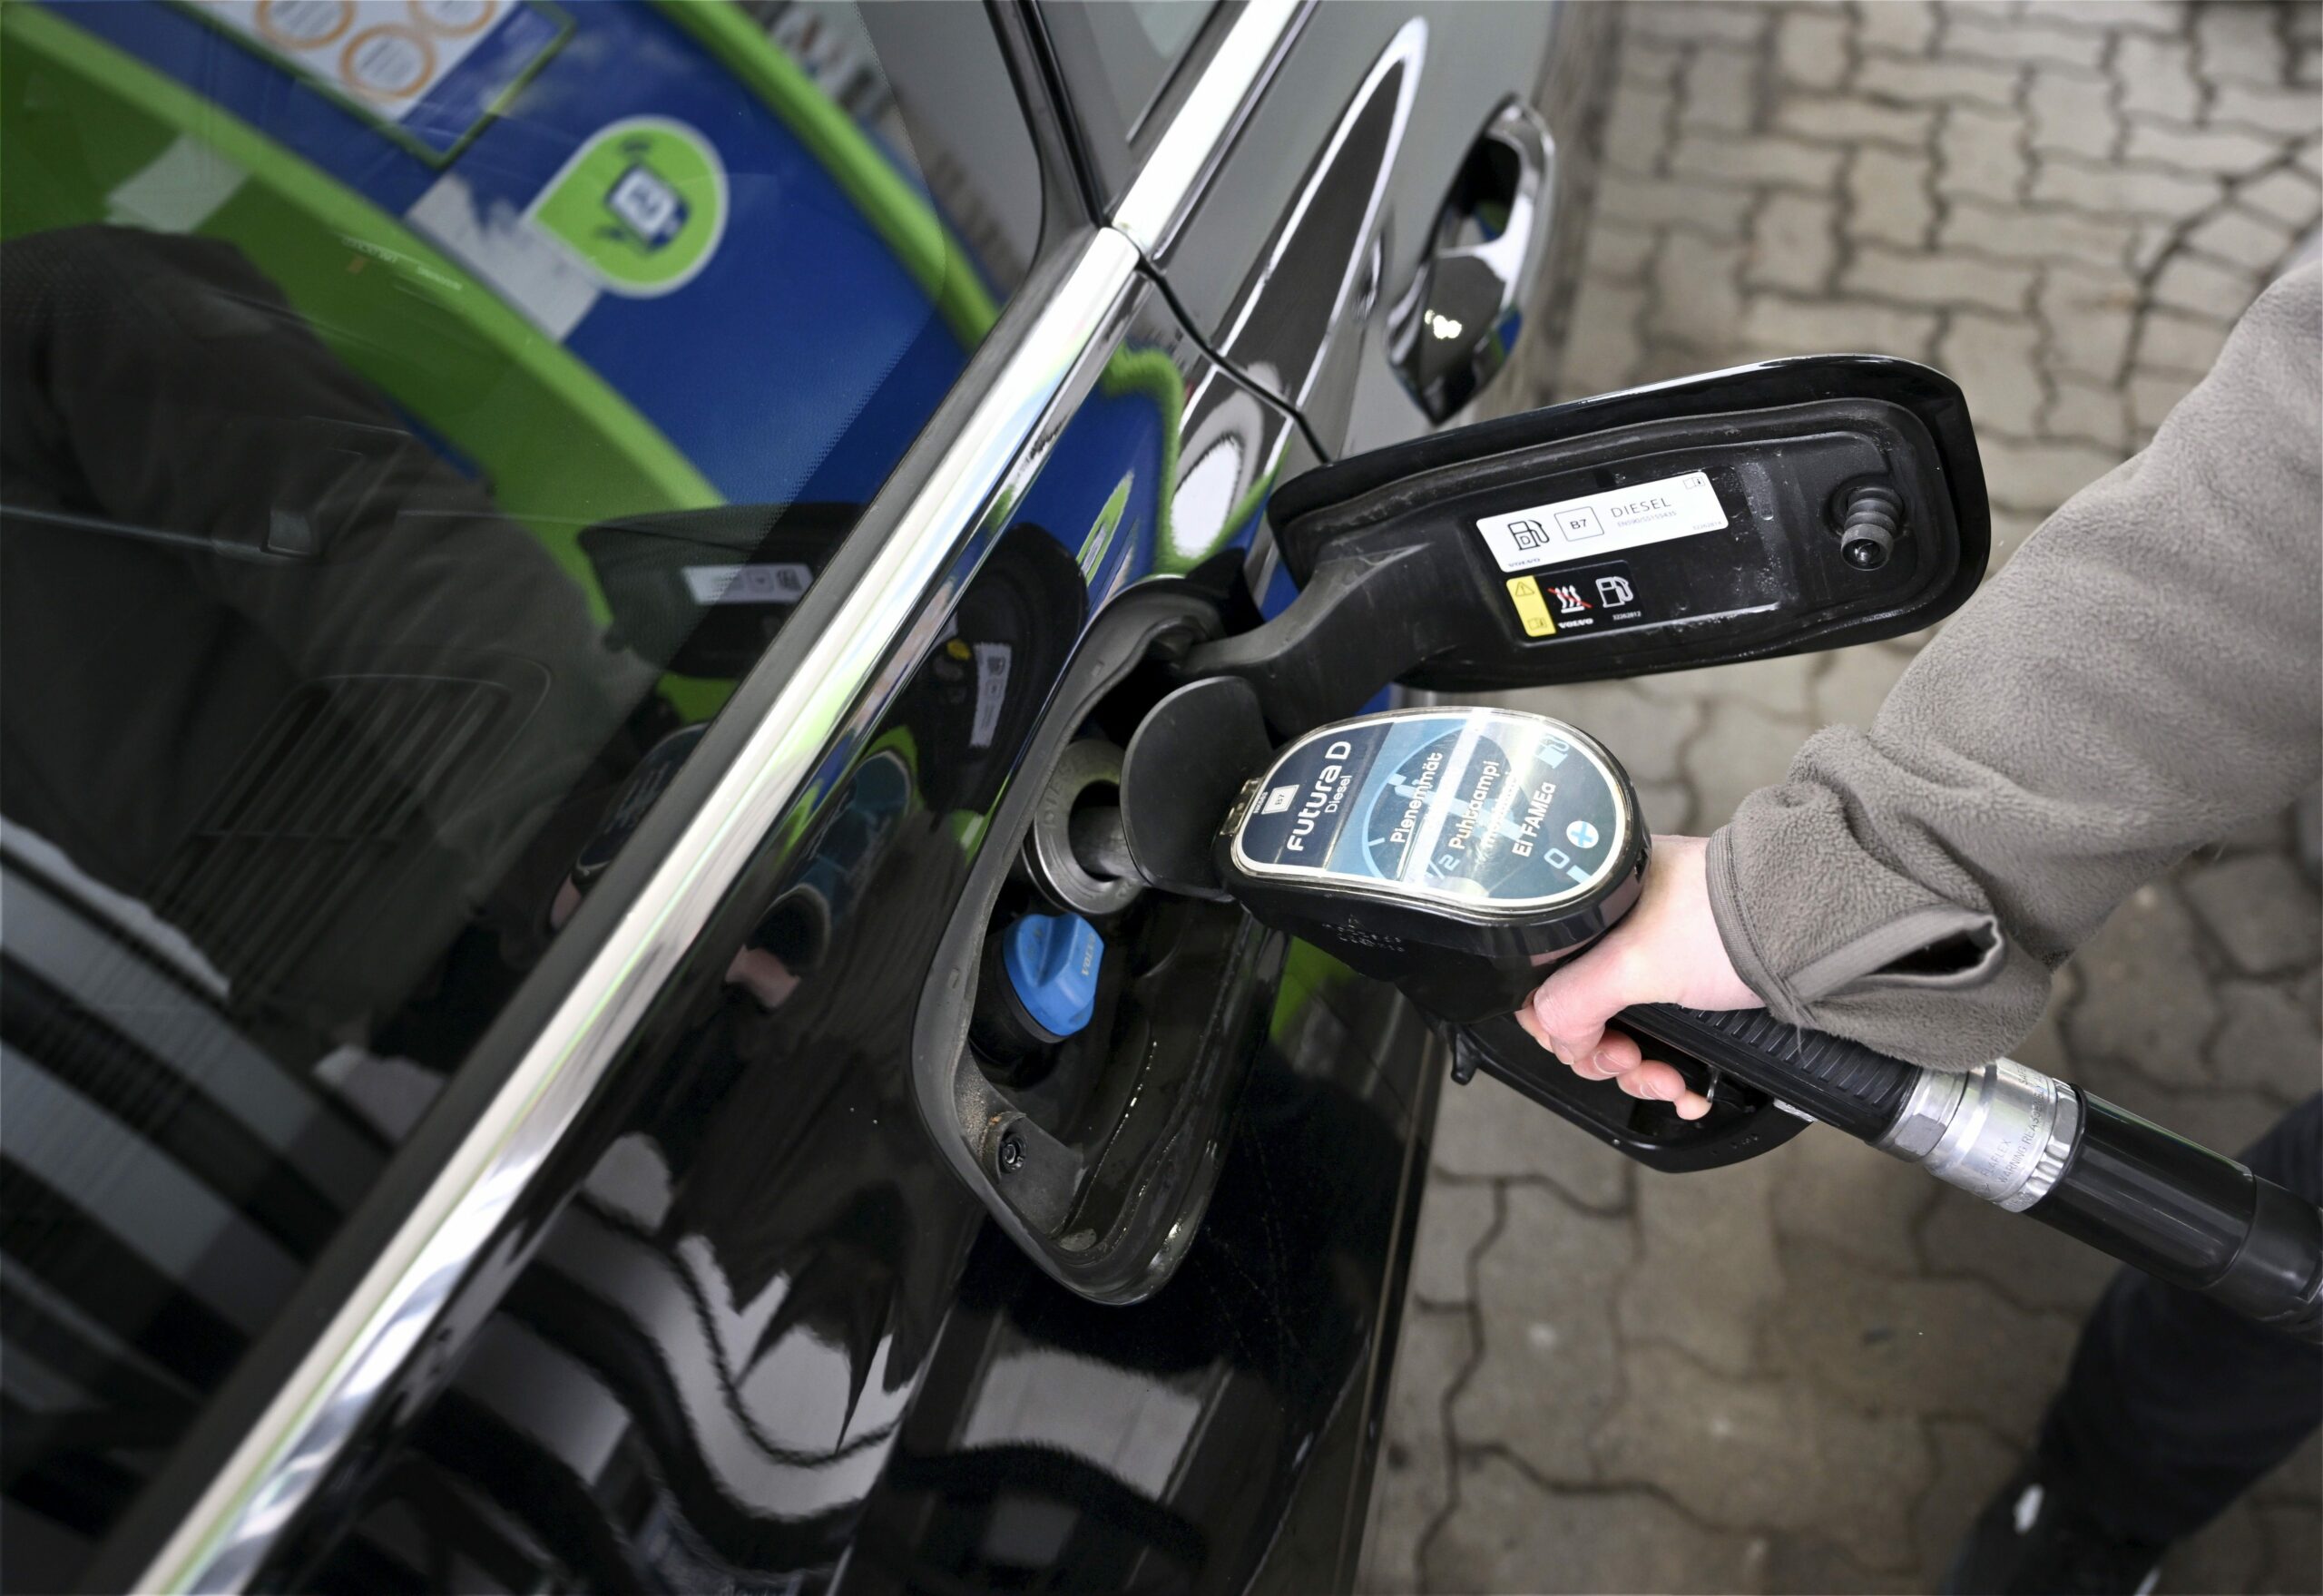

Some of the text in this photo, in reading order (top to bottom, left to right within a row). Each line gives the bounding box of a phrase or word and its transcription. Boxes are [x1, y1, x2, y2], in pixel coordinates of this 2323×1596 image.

[1570, 519, 1588, 530] B7
[1611, 497, 1671, 518] DIESEL
[1519, 535, 1531, 545] D
[1557, 617, 1594, 630] VOLVO
[1286, 740, 1352, 851] Futura D
[1324, 775, 1353, 814] Diesel
[1390, 751, 1444, 843] Pienemmät
[1448, 760, 1500, 850] Puhtaampi
[1512, 781, 1556, 857] Ei FAMEa
[1996, 1147, 2026, 1183] WARNING
